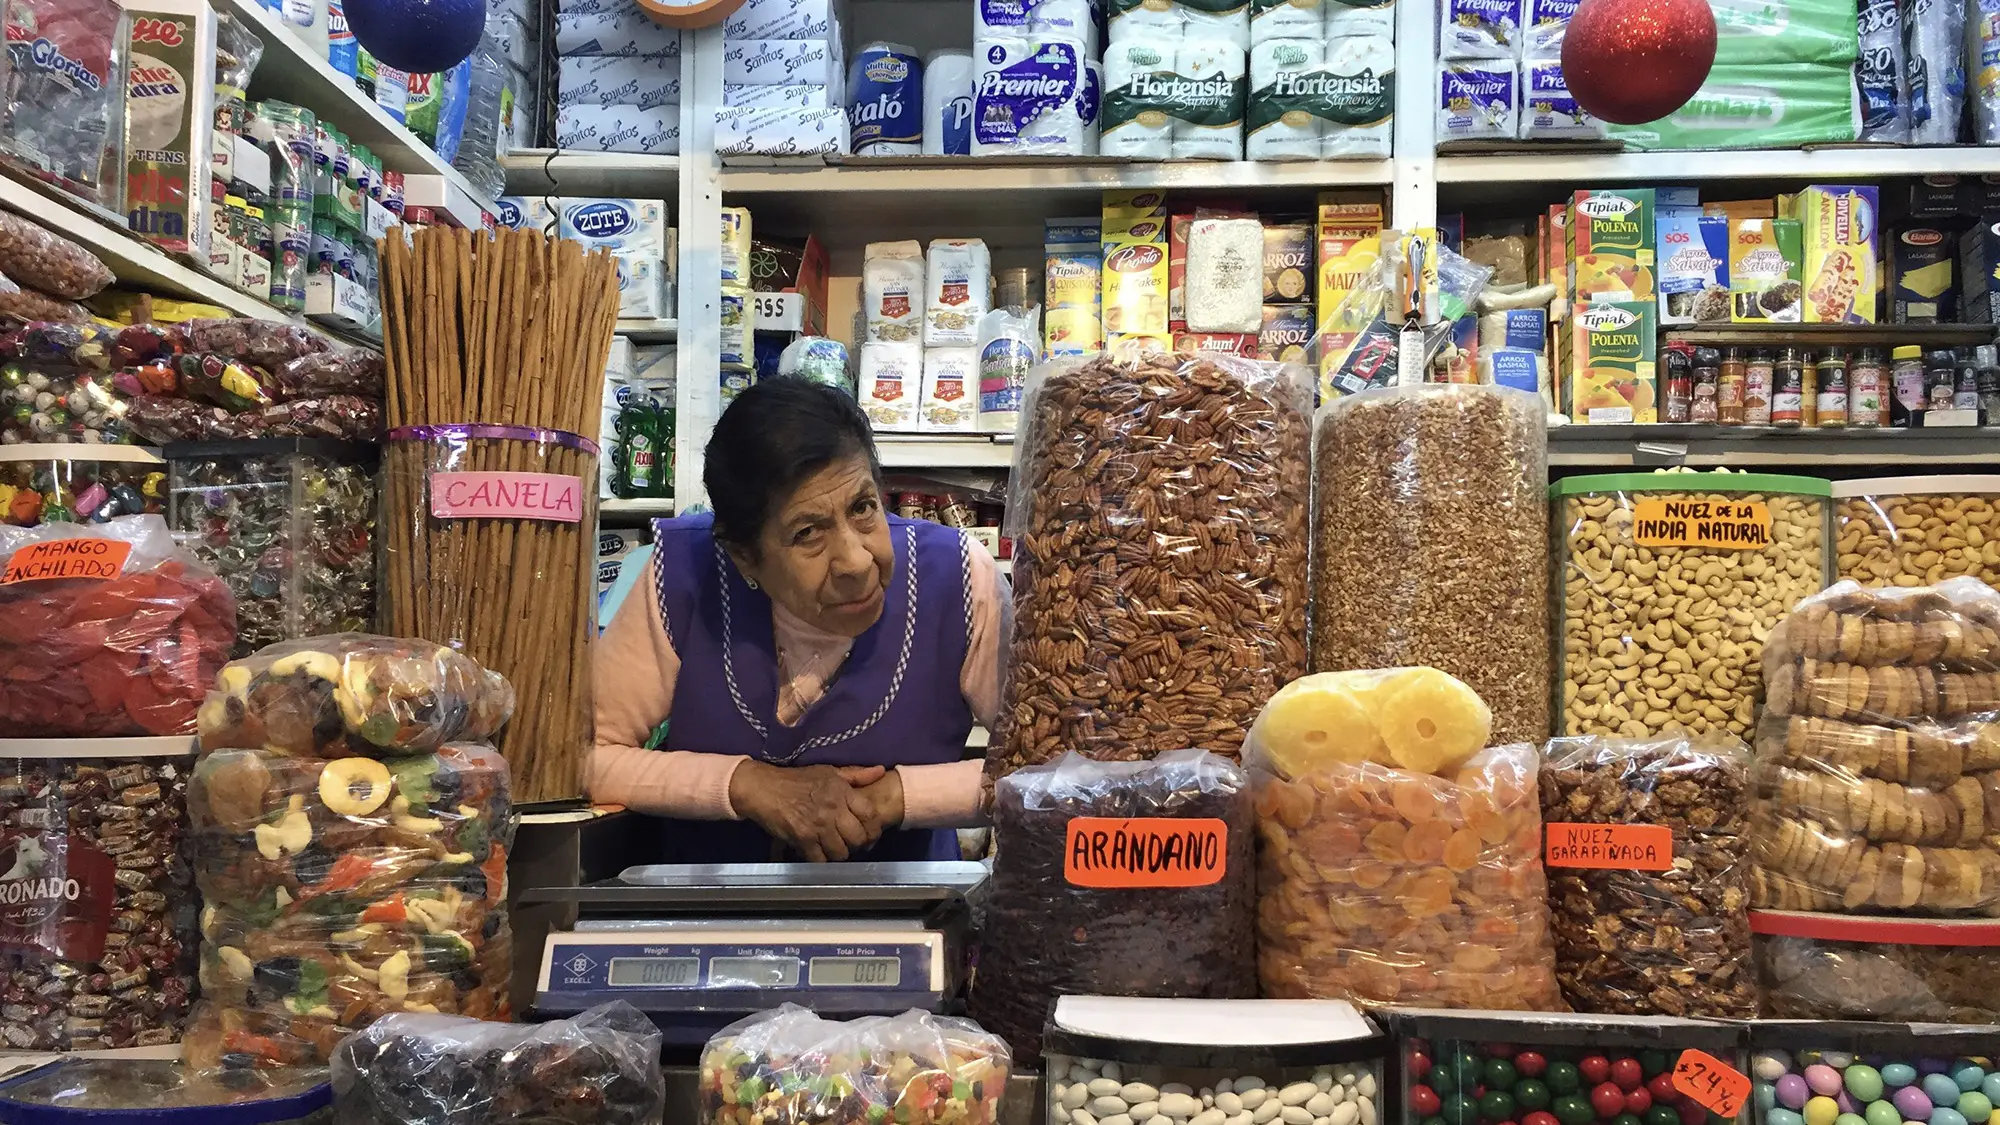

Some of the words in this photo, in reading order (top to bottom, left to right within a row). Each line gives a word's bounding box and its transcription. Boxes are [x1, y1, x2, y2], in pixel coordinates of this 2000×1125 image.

[1457, 13, 1480, 27] 125
[744, 48, 784, 74] Sanitas
[784, 49, 824, 74] Sanitas
[991, 47, 1002, 59] 4
[1863, 47, 1892, 71] 50
[31, 37, 100, 92] Glorias
[560, 79, 599, 104] Sanitas
[600, 79, 639, 104] Sanitas
[641, 79, 681, 104] Sanitas
[981, 70, 1070, 98] Premier
[1131, 71, 1234, 97] Hortensia
[1274, 71, 1381, 96] Hortensia
[1448, 78, 1506, 96] Premier
[1448, 97, 1471, 111] 125
[1535, 102, 1553, 112] 125
[558, 125, 598, 150] Sanitas
[599, 126, 639, 151] Sanitas
[640, 126, 680, 151] Sanitas
[1585, 201, 1628, 215] Tipiak
[578, 208, 625, 232] ZOTE
[1593, 219, 1640, 233] POLENTA
[1836, 198, 1849, 242] DIVELLA
[1665, 233, 1690, 244] SOS
[1738, 234, 1763, 244] SOS
[1910, 232, 1939, 242] Barilla
[1111, 246, 1162, 271] Pronto
[1668, 256, 1719, 274] Salvaje
[1739, 257, 1791, 275] Salvaje
[1055, 266, 1086, 277] Tipiak
[1511, 321, 1541, 329] BASMATI
[1583, 312, 1627, 327] Tipiak
[1201, 335, 1235, 351] Aunt
[1258, 329, 1309, 346] ARROZ
[1591, 333, 1640, 347] POLENTA
[1497, 362, 1531, 370] BASMATI
[1499, 356, 1527, 364] ARROZ
[446, 479, 574, 512] CANELA
[1665, 503, 1713, 519] NUEZ
[1737, 505, 1754, 519] LA
[1697, 521, 1769, 545] NATURAL
[30, 540, 109, 560] MANGO
[1, 559, 117, 583] ENCHILADO
[1567, 828, 1614, 846] NUEZ
[1072, 821, 1218, 874] ARÁNDANO
[1551, 844, 1657, 862] GARAPIÑADA
[22, 906, 46, 918] 1932
[644, 947, 669, 956] Weight
[857, 948, 876, 956] Price
[564, 976, 593, 984] EXCELL
